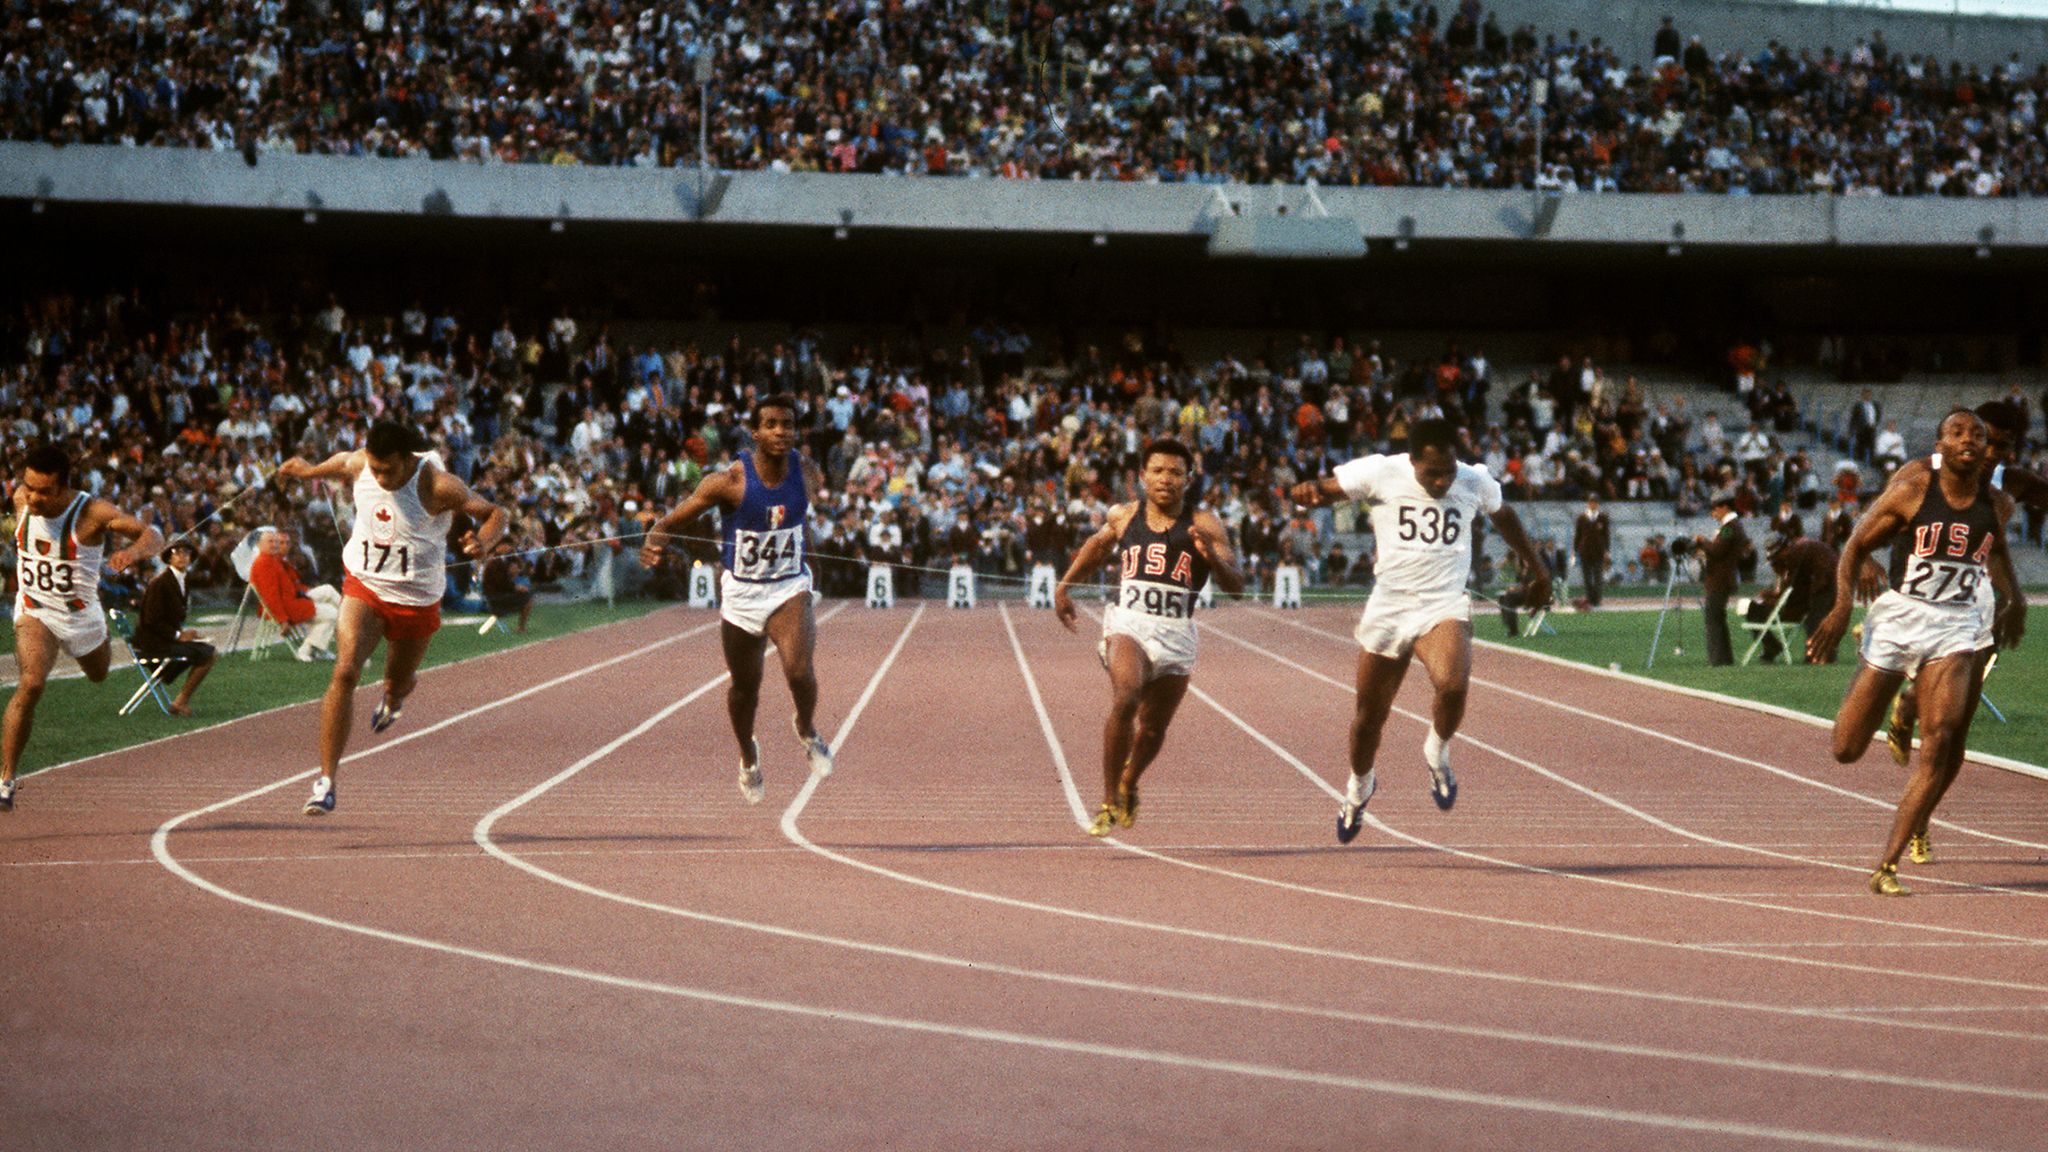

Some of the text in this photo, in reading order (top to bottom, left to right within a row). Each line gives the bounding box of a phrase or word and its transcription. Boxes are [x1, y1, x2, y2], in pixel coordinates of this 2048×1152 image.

[1399, 505, 1462, 545] 536
[362, 540, 408, 577] 171
[741, 532, 796, 567] 344
[1121, 543, 1192, 587] USA
[21, 556, 73, 592] 583
[697, 576, 707, 598] 8
[875, 576, 886, 598] 6
[956, 576, 968, 598] 5
[1039, 577, 1049, 599] 4
[1908, 561, 1978, 602] 279
[1126, 585, 1183, 619] 295
